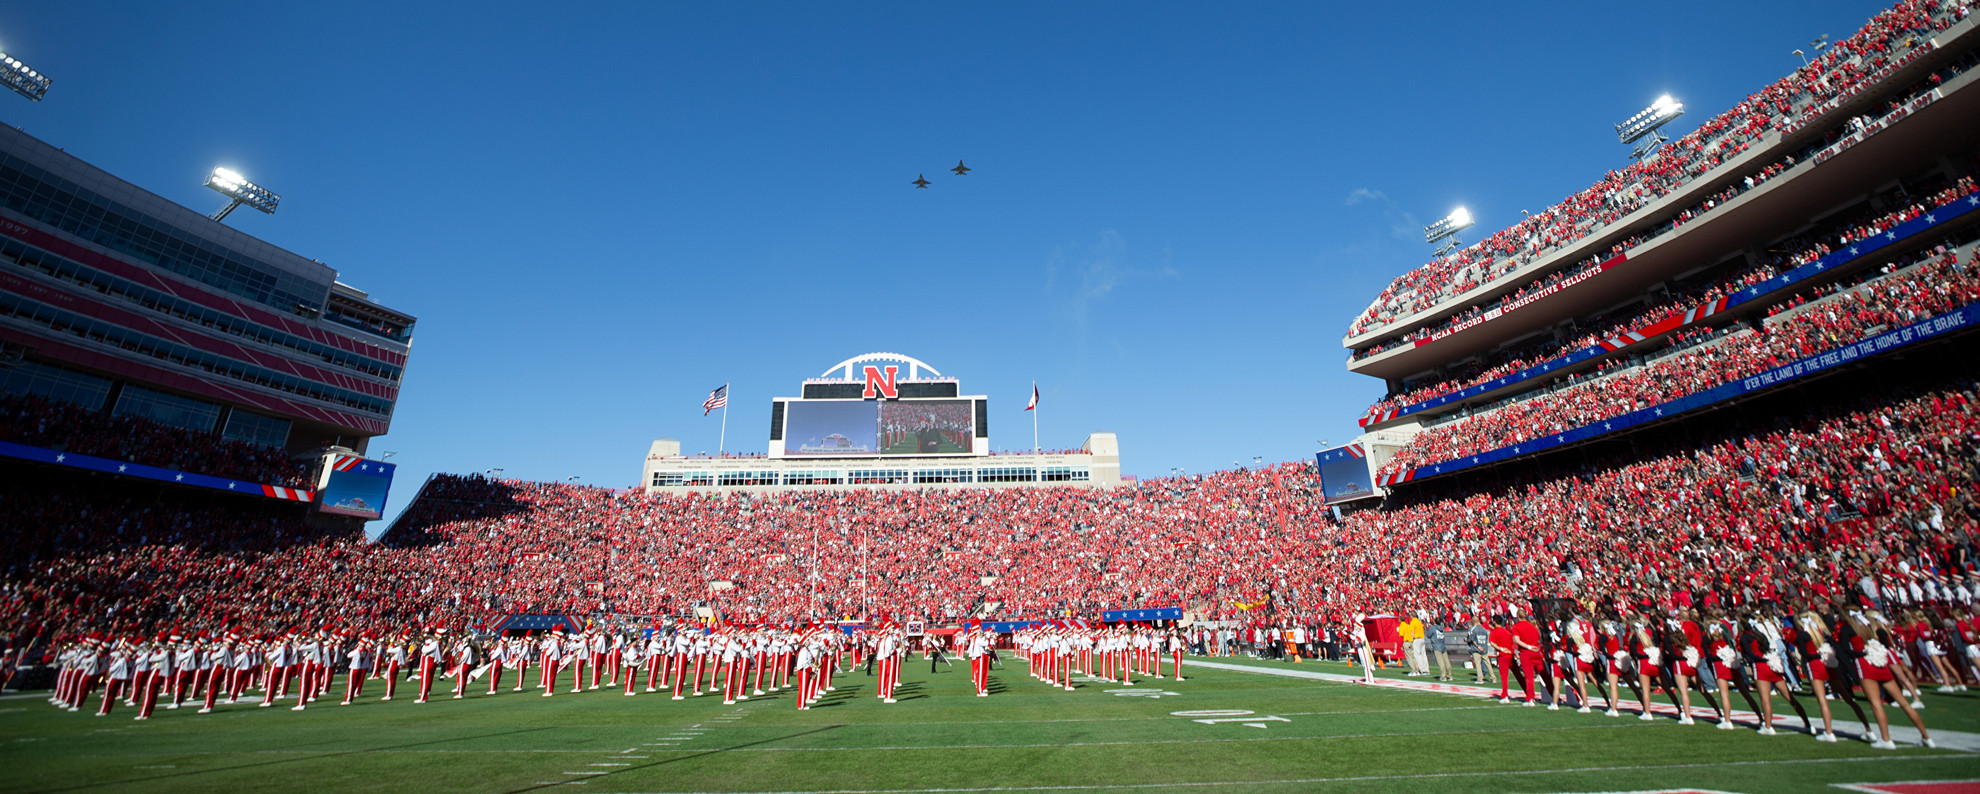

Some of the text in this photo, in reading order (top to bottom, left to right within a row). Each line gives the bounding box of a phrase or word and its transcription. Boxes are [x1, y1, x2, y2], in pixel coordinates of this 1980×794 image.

[1781, 40, 1934, 137] NATIONAL CHAMPIONSHIPS
[1431, 265, 1603, 342] NCAA RECORD 380 CONSECUTIVE SELLOUTS
[863, 365, 899, 399] N
[1744, 311, 1966, 390] O'ER THE LAND OF THE FREE AND THE HOME OF THE BRAVE
